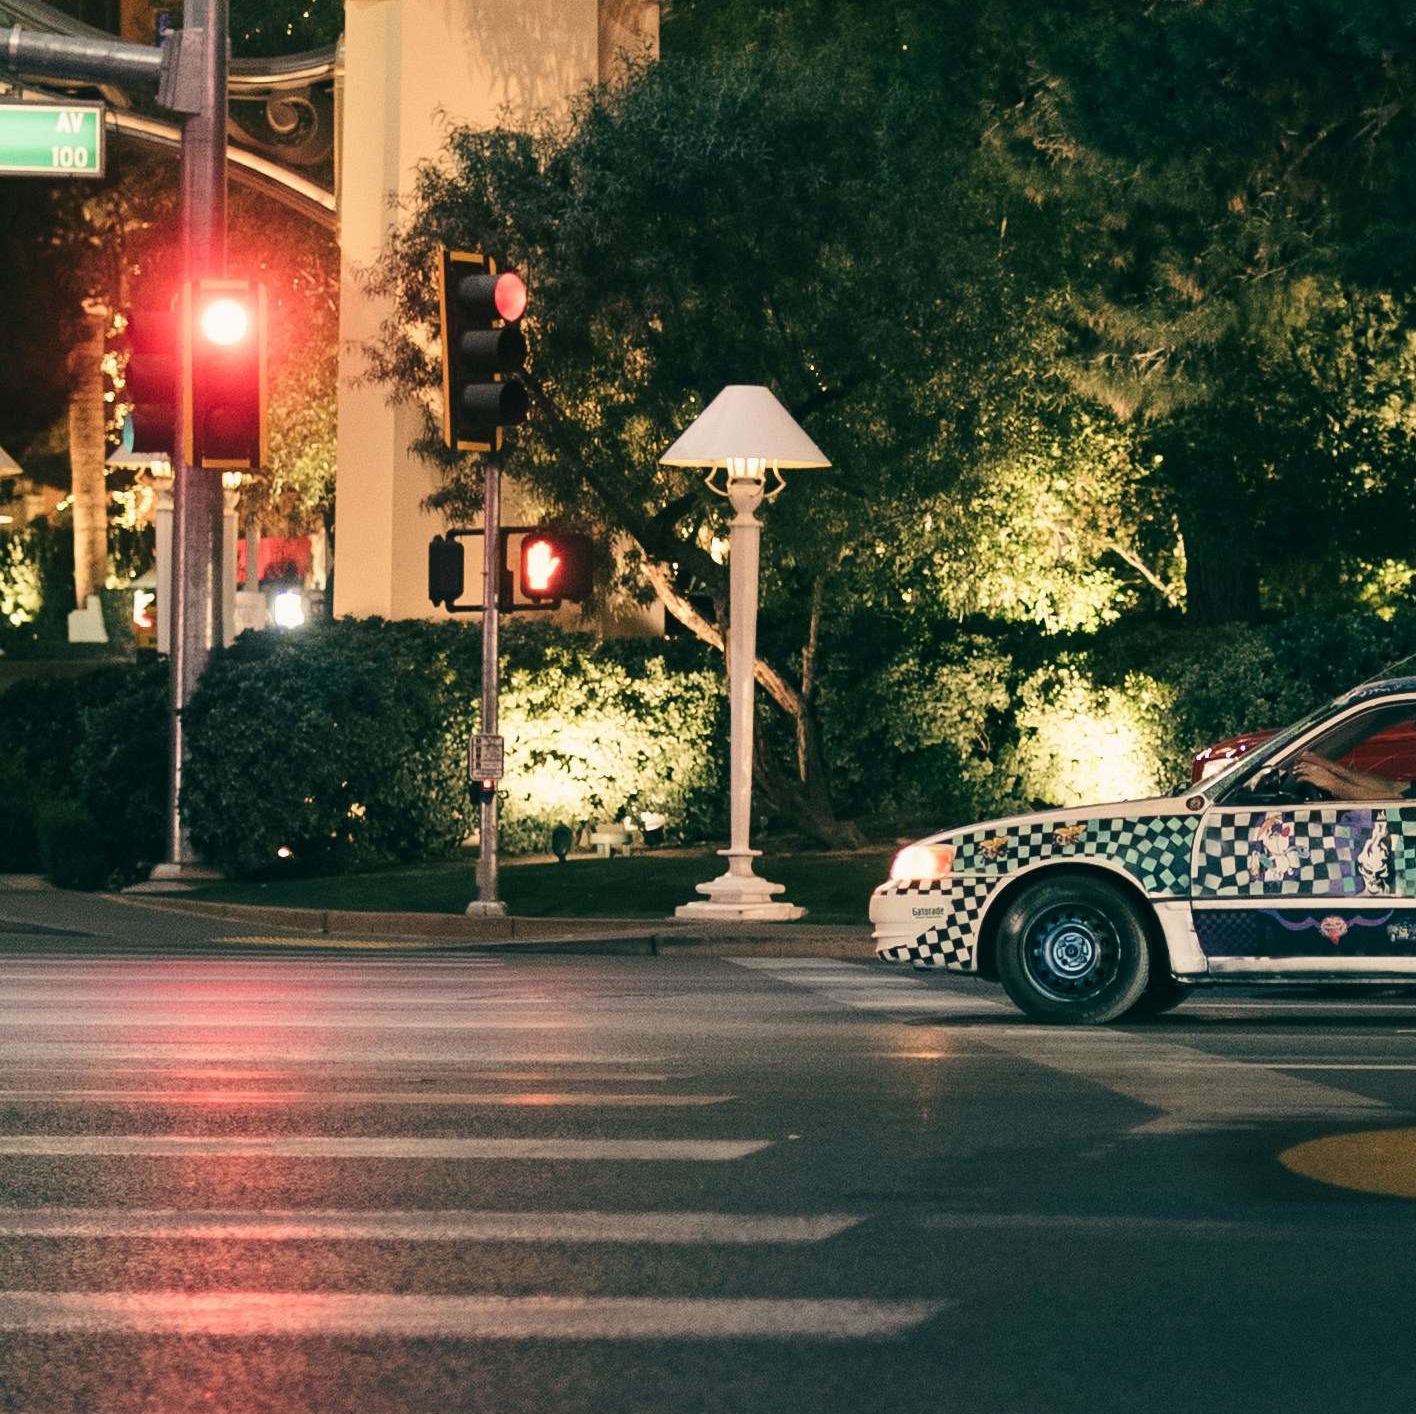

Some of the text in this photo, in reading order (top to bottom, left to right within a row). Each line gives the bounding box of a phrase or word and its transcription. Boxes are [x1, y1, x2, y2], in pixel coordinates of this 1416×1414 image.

[56, 112, 84, 134] AV
[51, 145, 89, 168] 100
[912, 907, 944, 916] Gatorade
